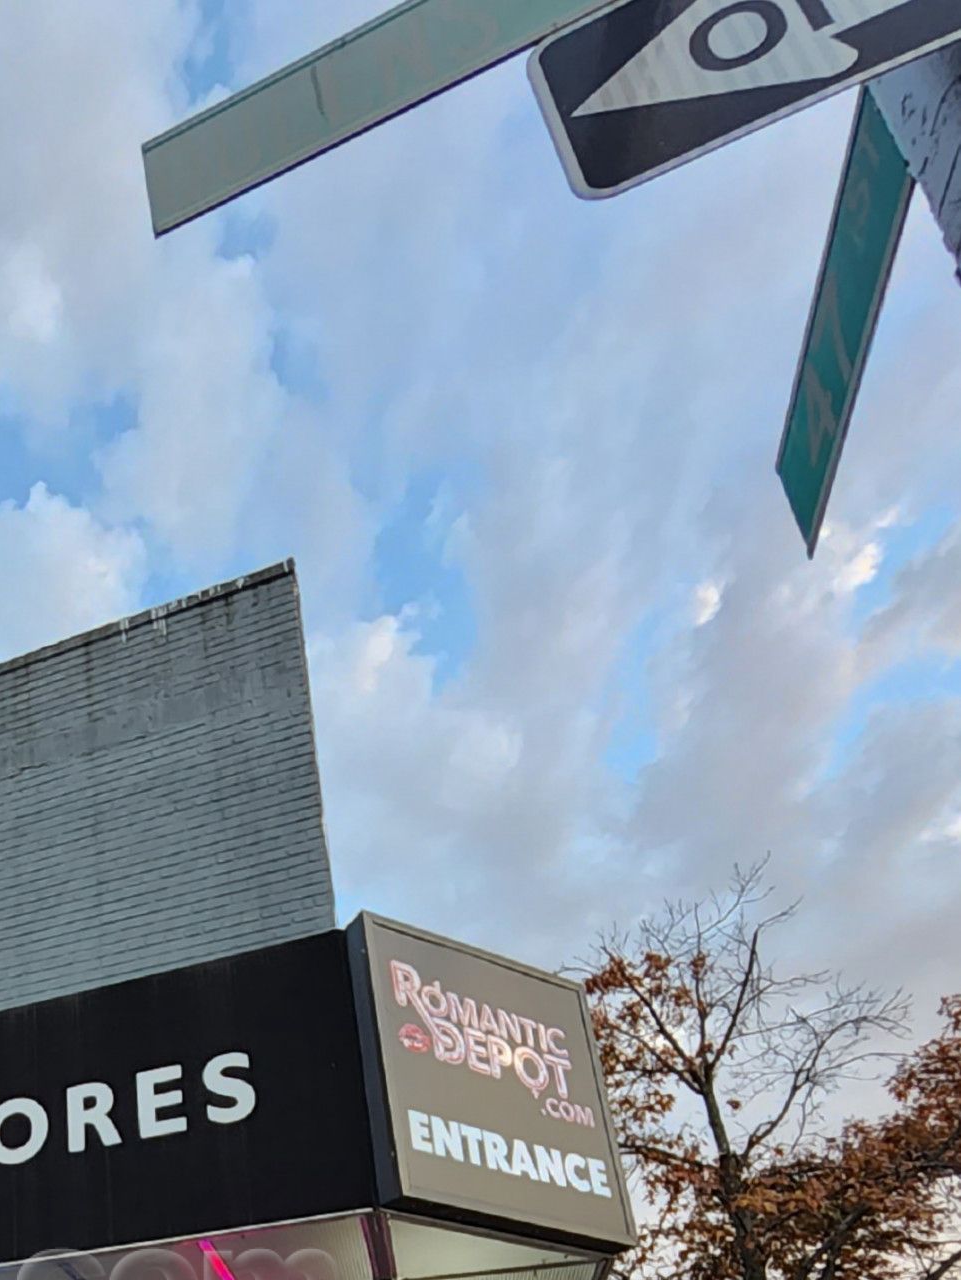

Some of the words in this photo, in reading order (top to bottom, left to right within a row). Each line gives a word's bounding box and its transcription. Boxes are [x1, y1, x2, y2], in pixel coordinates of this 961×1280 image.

[389, 959, 570, 1058] ROMANTIC
[431, 1017, 572, 1100] DEPOT
[407, 1109, 613, 1199] ENTRANCE
[540, 1096, 596, 1128] .COM
